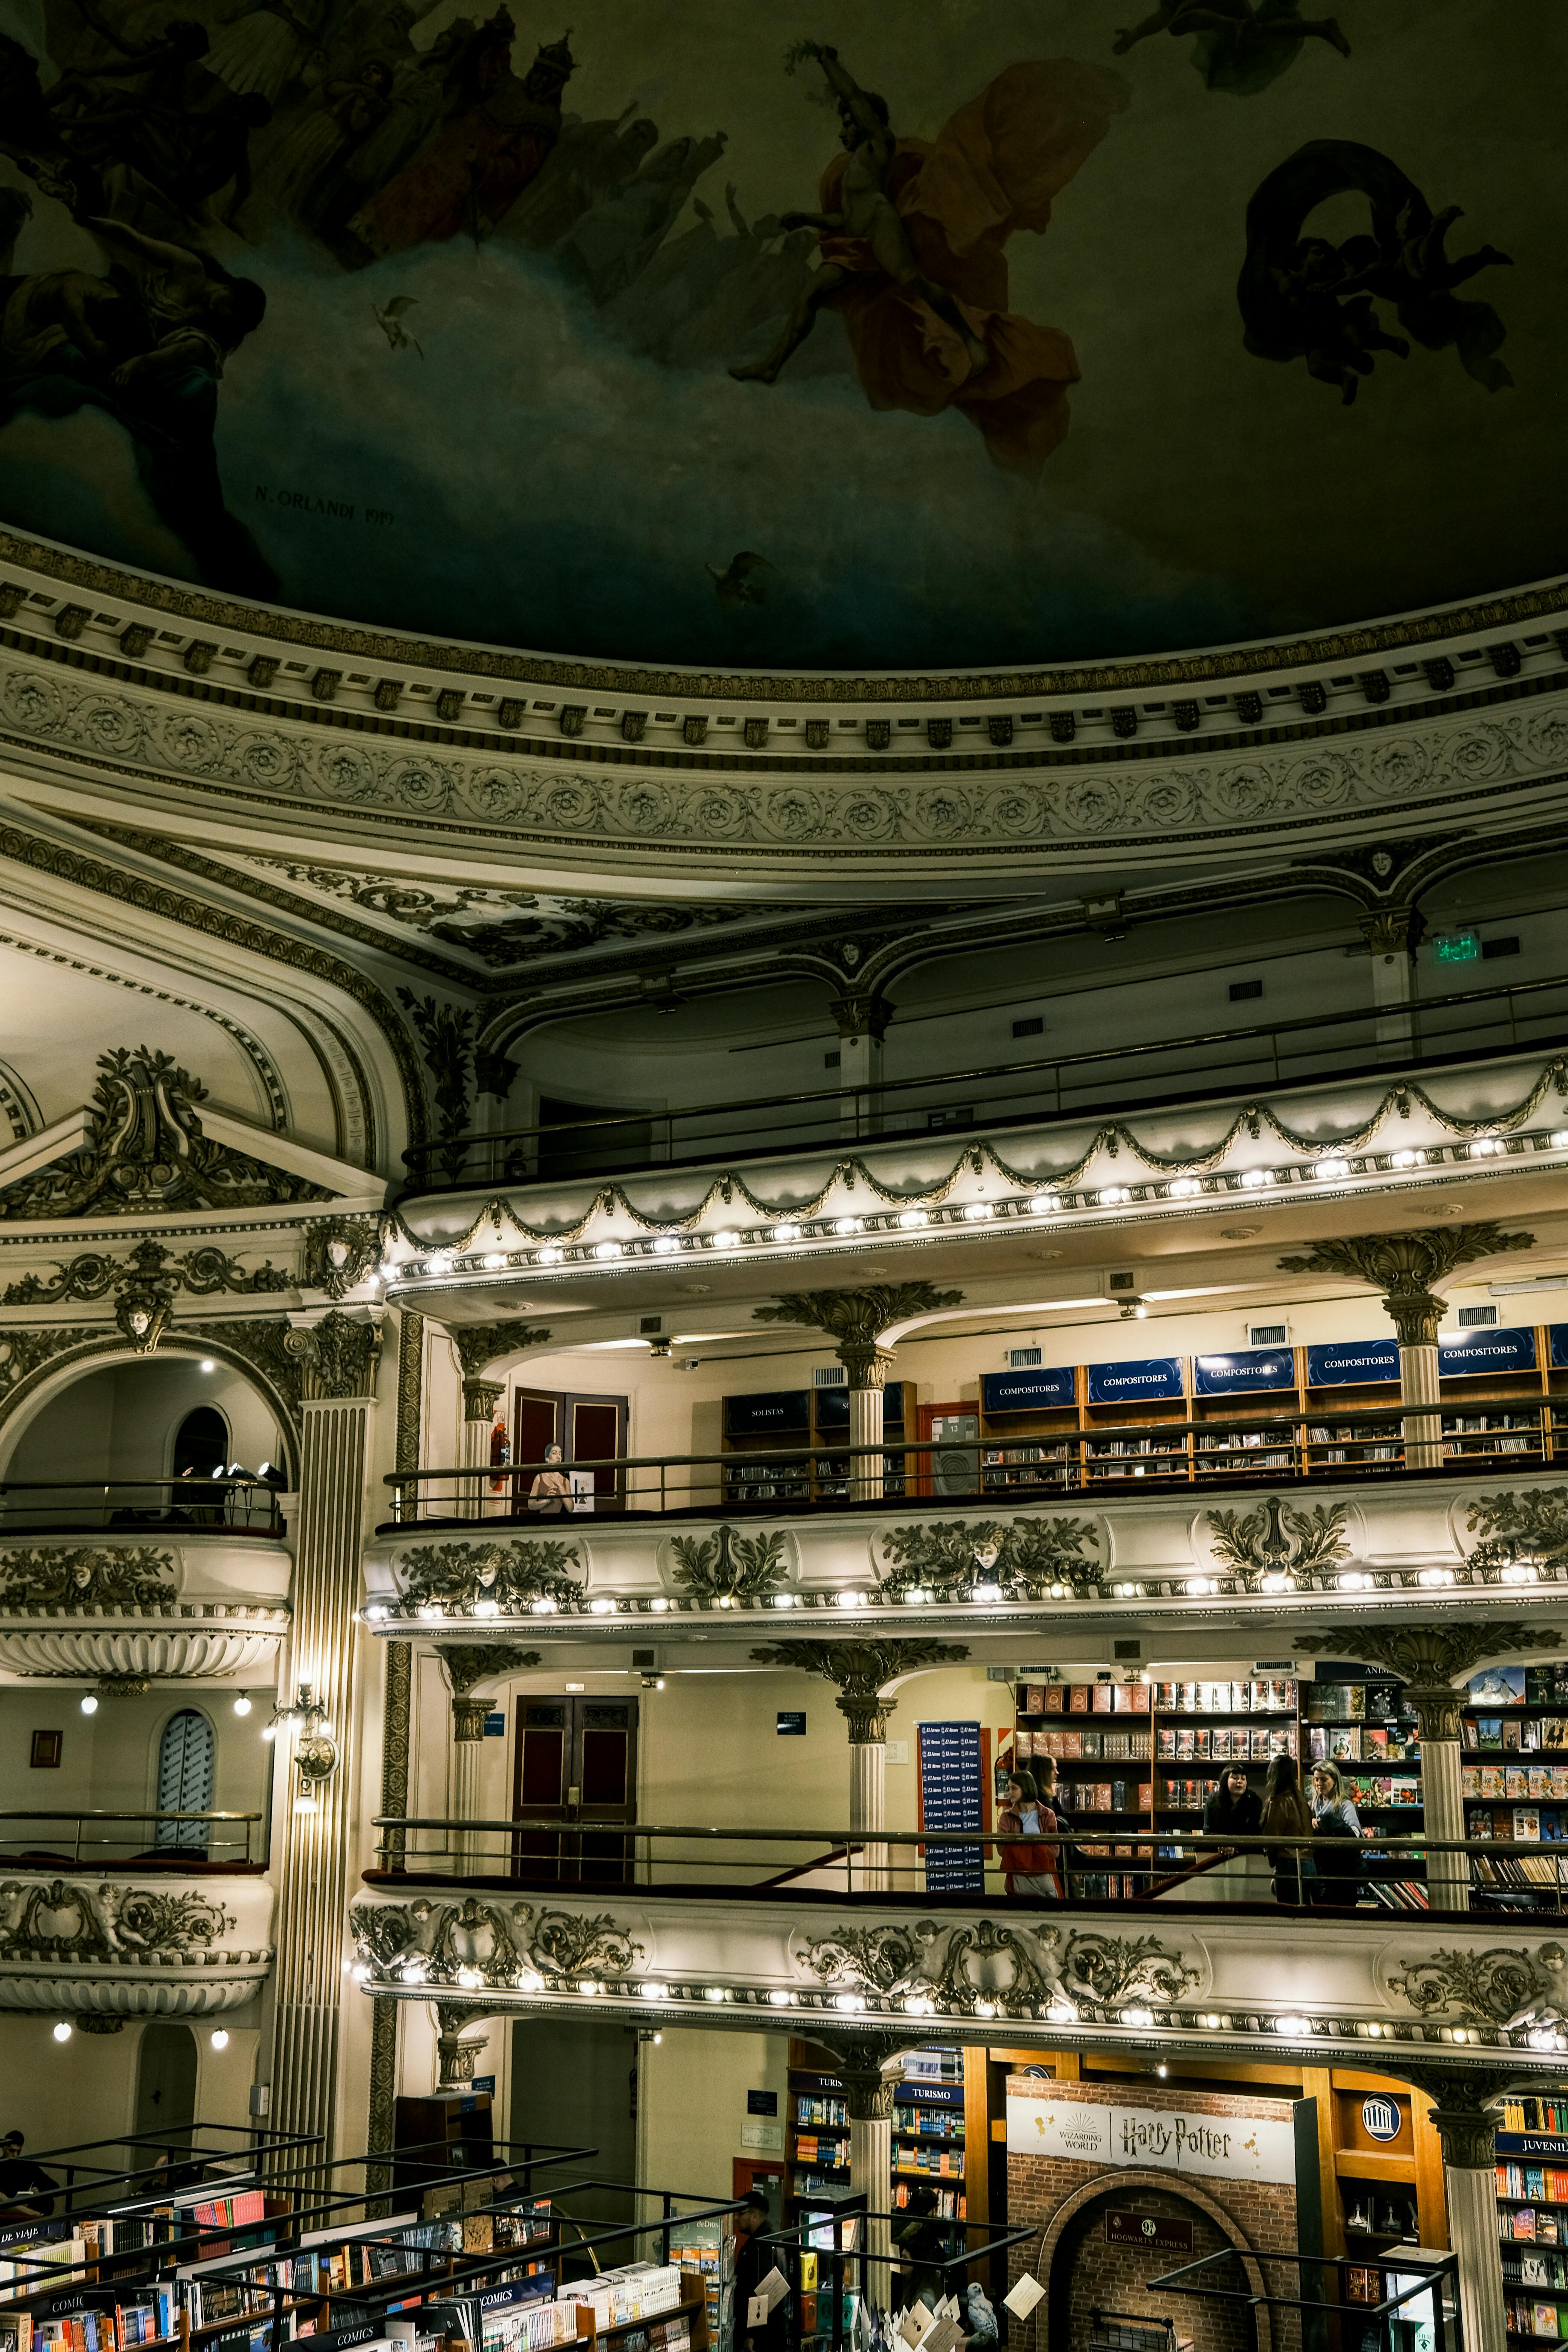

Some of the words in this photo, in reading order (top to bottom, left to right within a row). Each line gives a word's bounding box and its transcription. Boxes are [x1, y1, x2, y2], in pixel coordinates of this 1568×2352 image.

[278, 490, 355, 520] ORLANDI
[1443, 1345, 1517, 1359] COMPOSITORES
[1324, 1356, 1395, 1369] COMPOSITORES
[1103, 1374, 1167, 1387] COMPOSITORES
[999, 1384, 1060, 1396] COMPOSITORES
[751, 1407, 785, 1417] SOLISTAS
[912, 2088, 951, 2099] TURISMO
[1060, 2131, 1102, 2143] WIZARDING
[1119, 2118, 1173, 2157] Harry
[1174, 2118, 1231, 2164] Potter
[1065, 2141, 1098, 2151] WORLD
[1, 2233, 14, 2243] DE
[16, 2226, 39, 2240] VIAJE
[1111, 2233, 1152, 2245] HOGWARTS
[1155, 2239, 1188, 2249] EXPRESS
[482, 2289, 513, 2306] COMICS
[337, 2326, 374, 2346] COMICS
